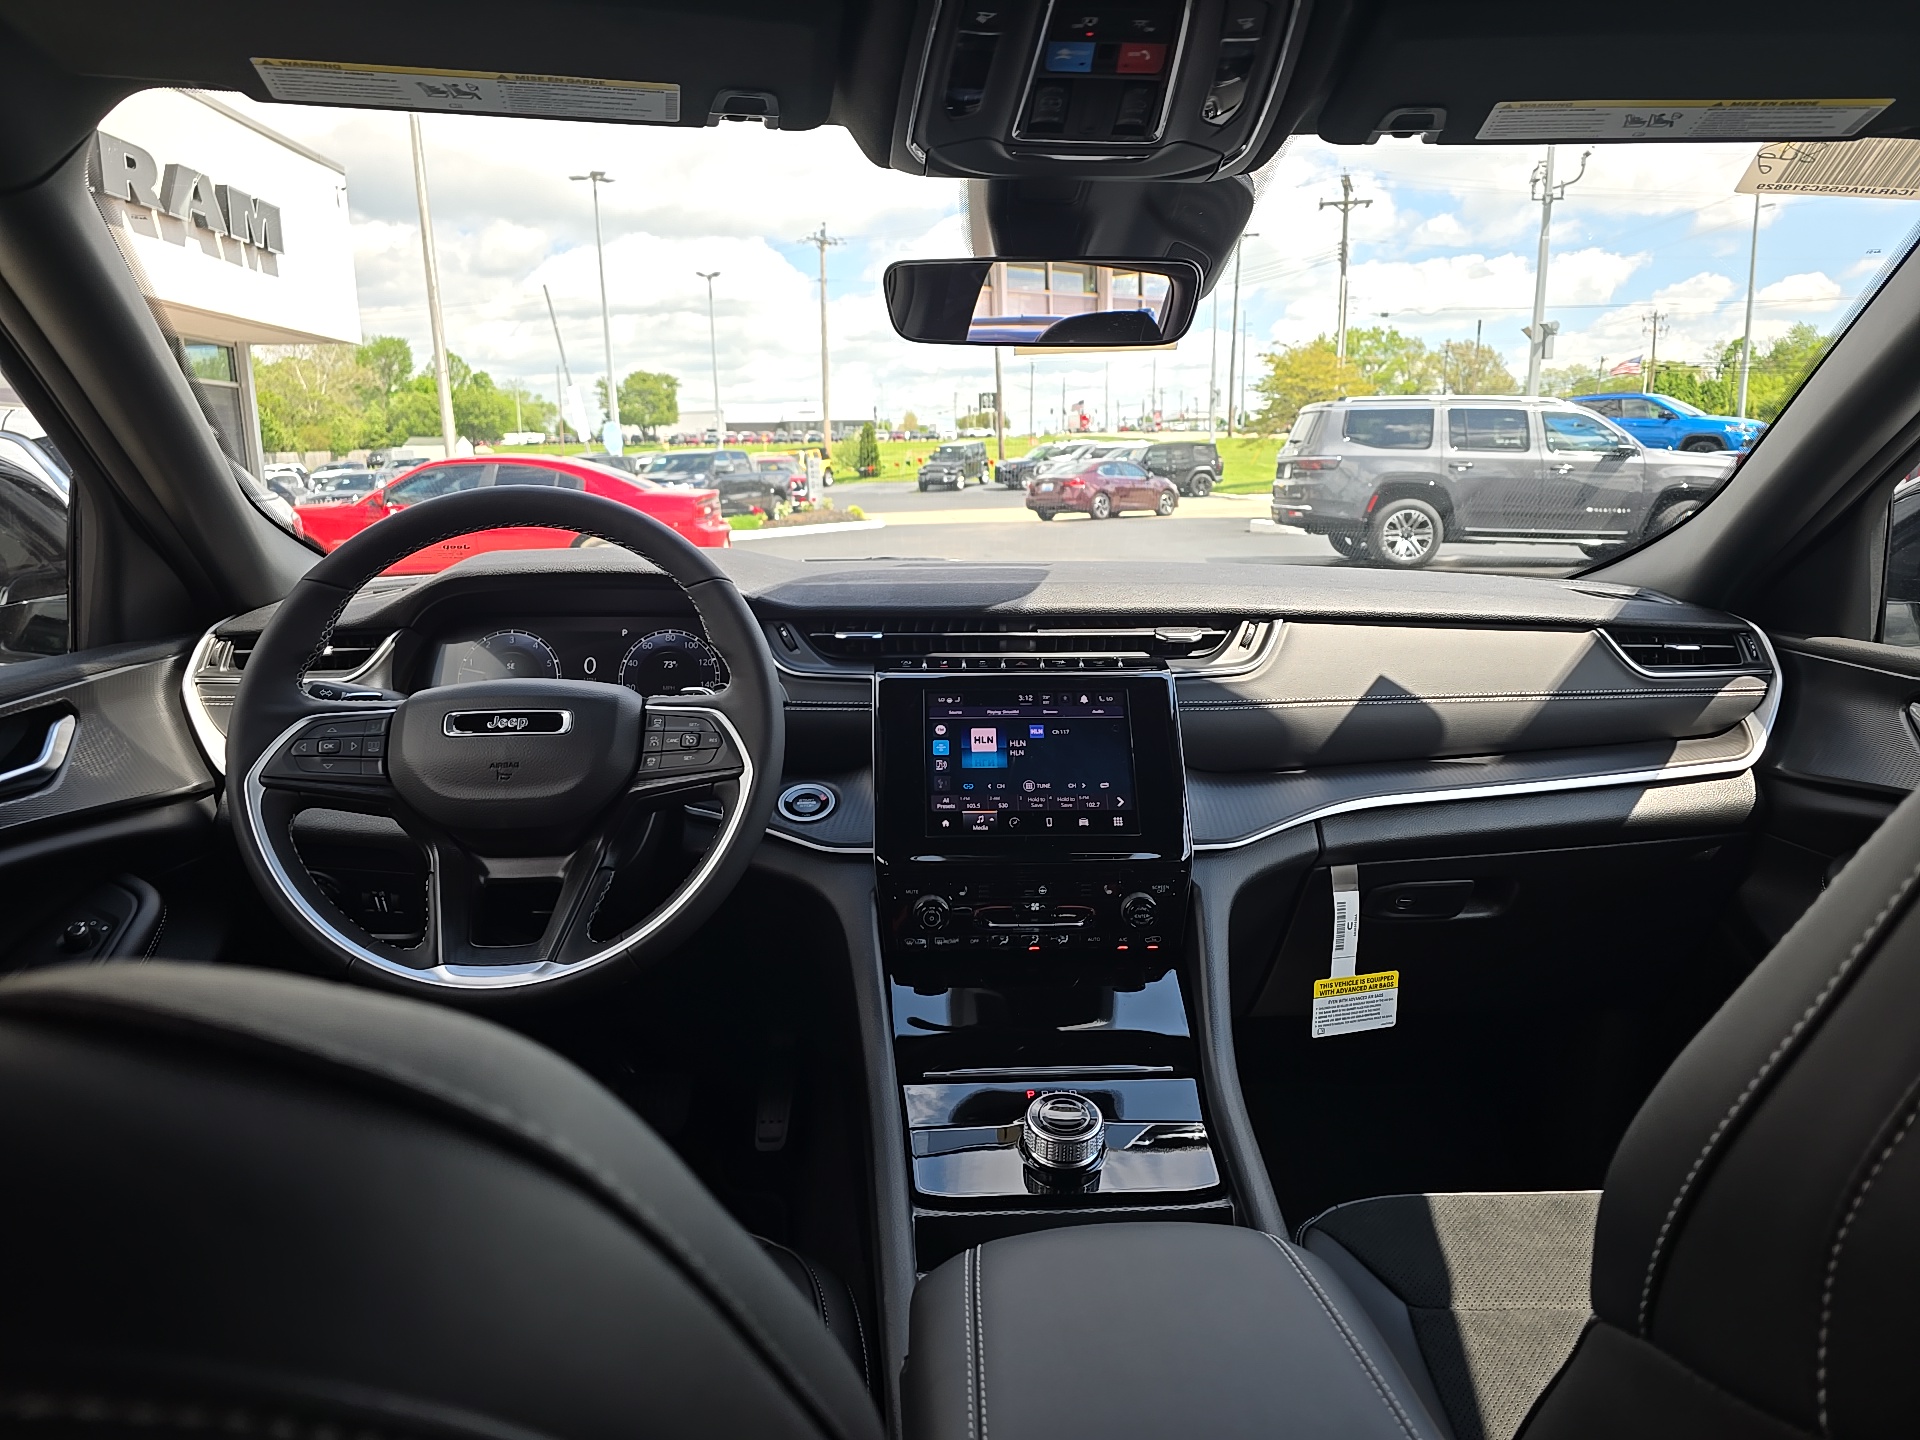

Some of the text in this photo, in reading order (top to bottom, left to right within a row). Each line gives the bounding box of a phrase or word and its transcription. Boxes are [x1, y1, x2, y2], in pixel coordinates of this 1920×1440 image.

[566, 78, 606, 86] GARDE
[97, 129, 285, 255] RAM
[622, 629, 628, 637] P
[584, 656, 597, 675] 0
[1018, 694, 1033, 702] 3:12
[486, 715, 529, 730] Jeep
[974, 736, 994, 744] HLN
[1010, 740, 1027, 748] HLN
[489, 761, 520, 769] AIRBAG
[1334, 979, 1358, 988] VEHICLE
[1366, 975, 1395, 984] EQUIPPED
[1336, 984, 1367, 994] ADVANCED
[1378, 981, 1394, 989] BAGS
[1026, 1090, 1036, 1099] P
